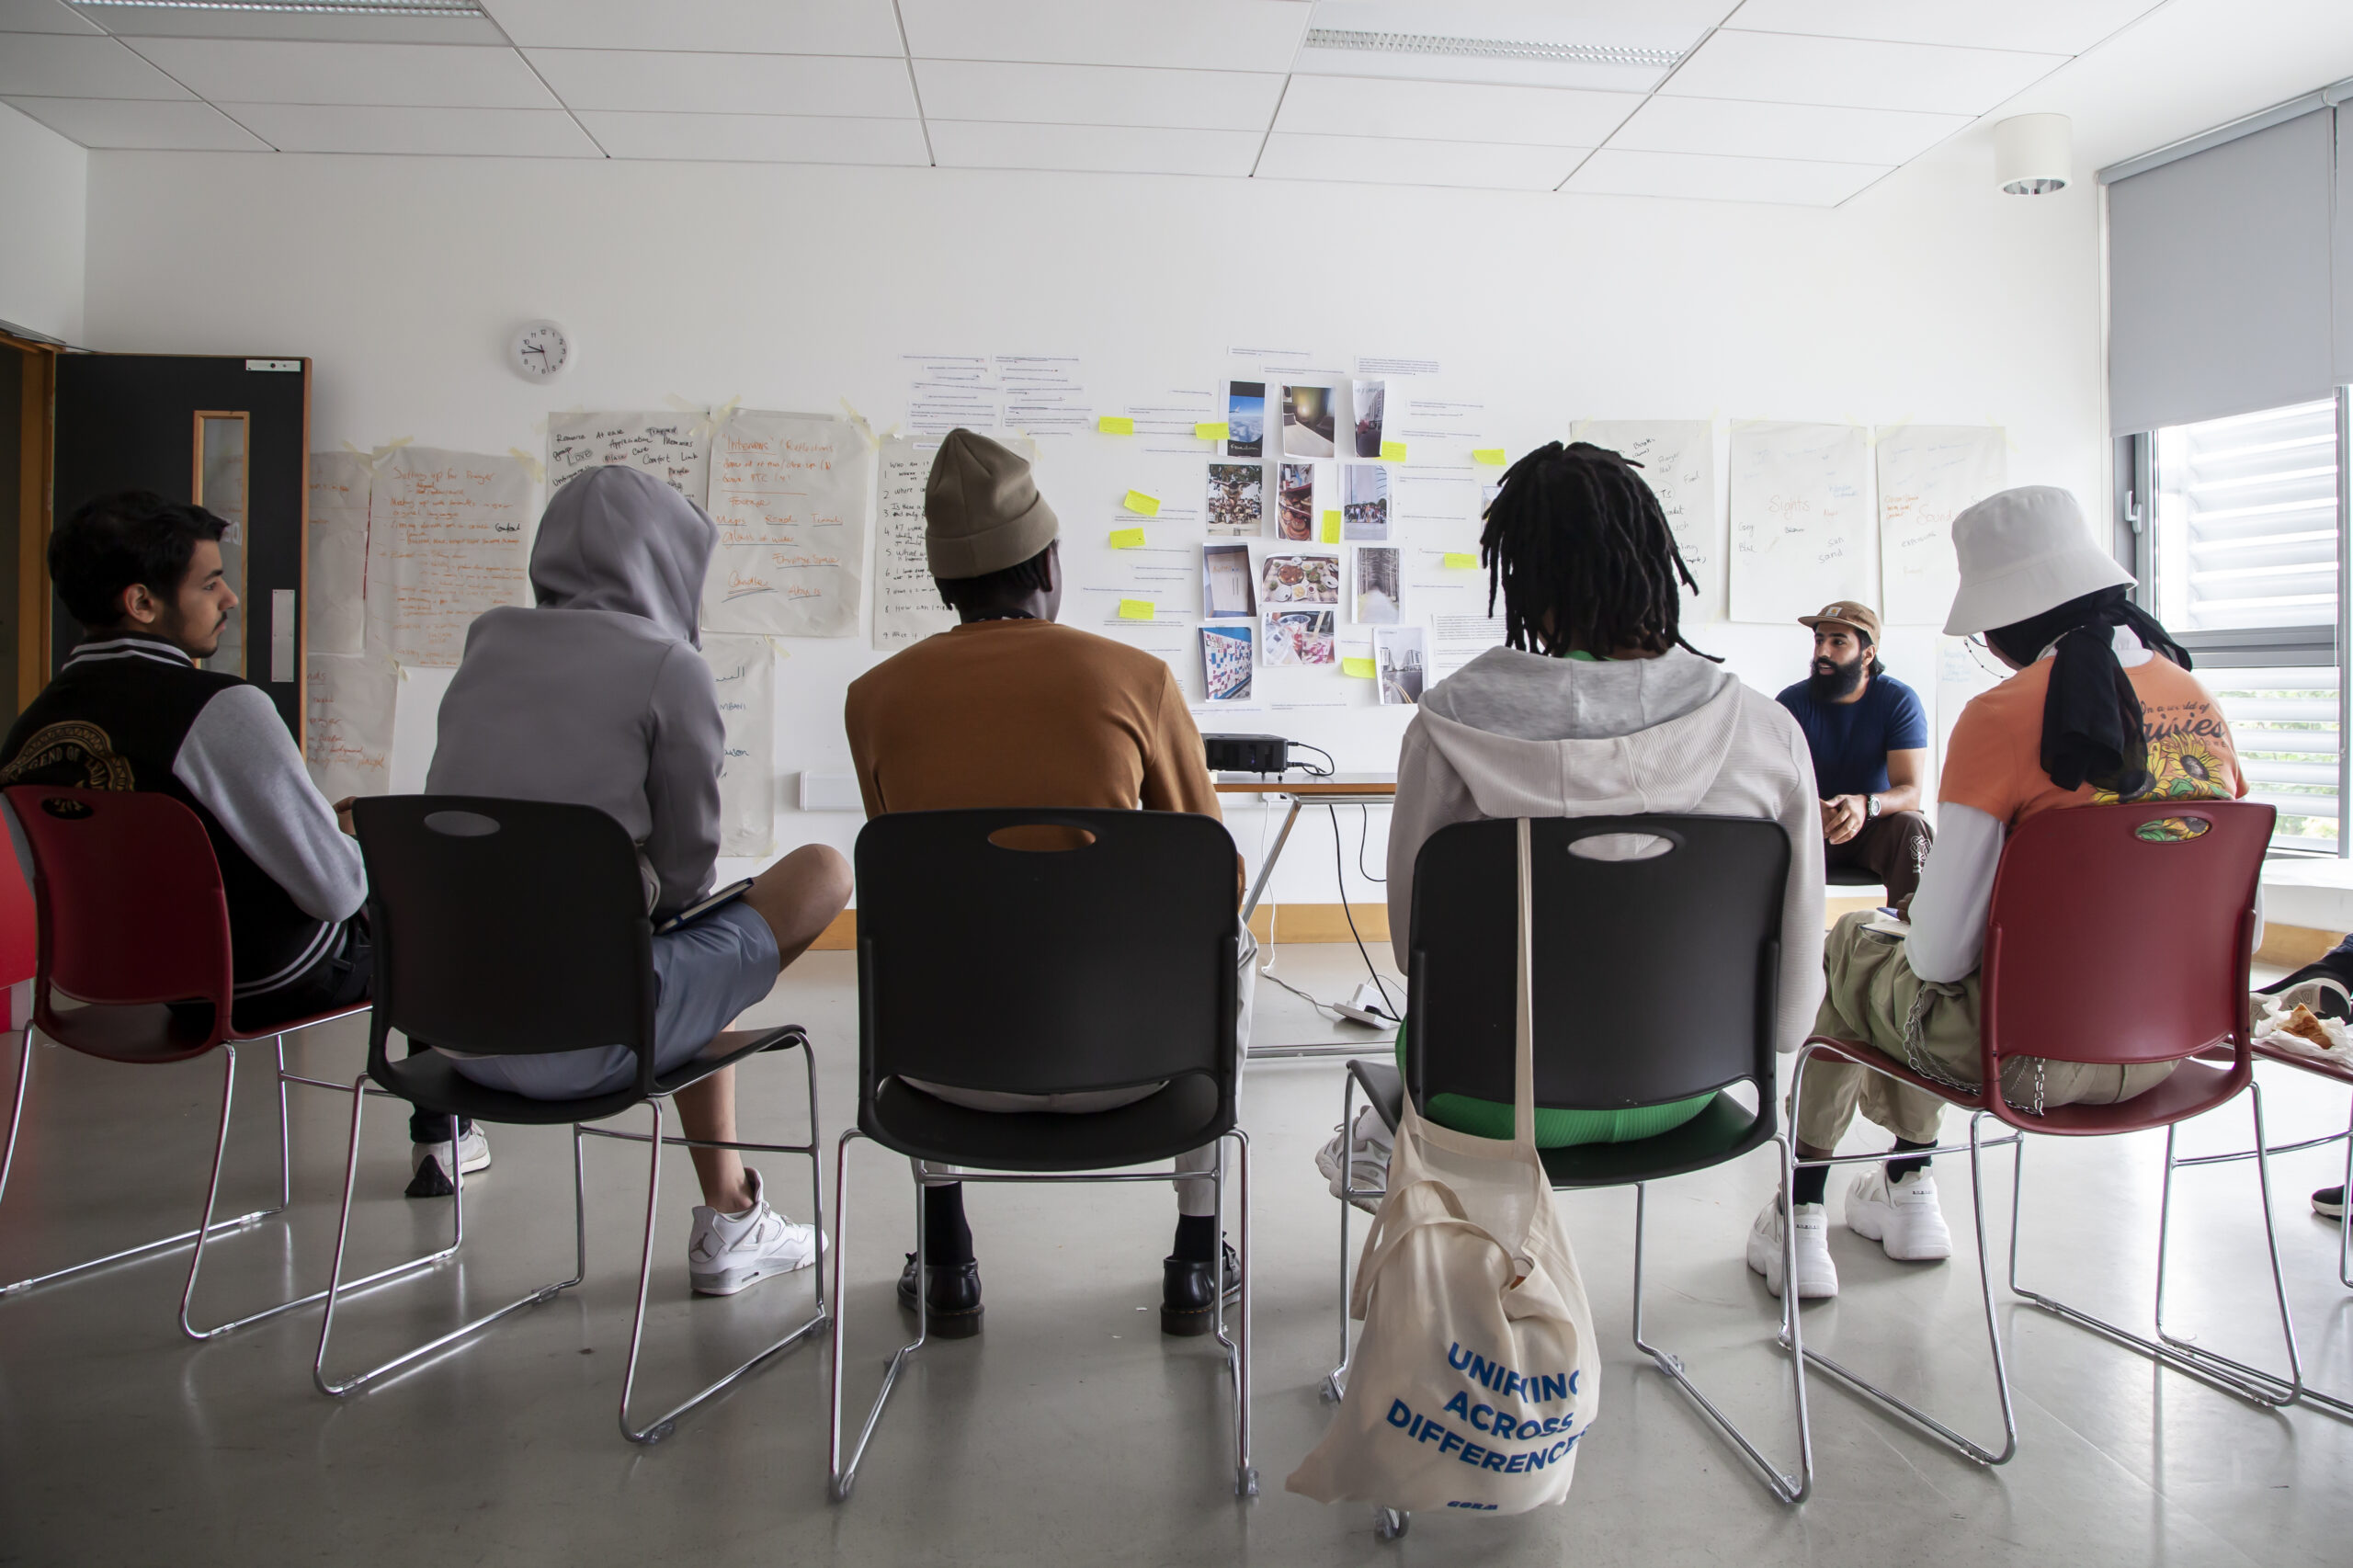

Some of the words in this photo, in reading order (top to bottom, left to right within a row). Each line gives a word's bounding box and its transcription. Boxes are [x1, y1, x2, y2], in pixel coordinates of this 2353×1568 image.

[1768, 494, 1810, 521] Sights
[2143, 711, 2224, 743] aisies
[1386, 1397, 1592, 1473] DIFFERENCE
[1443, 1390, 1574, 1441] ACROSS
